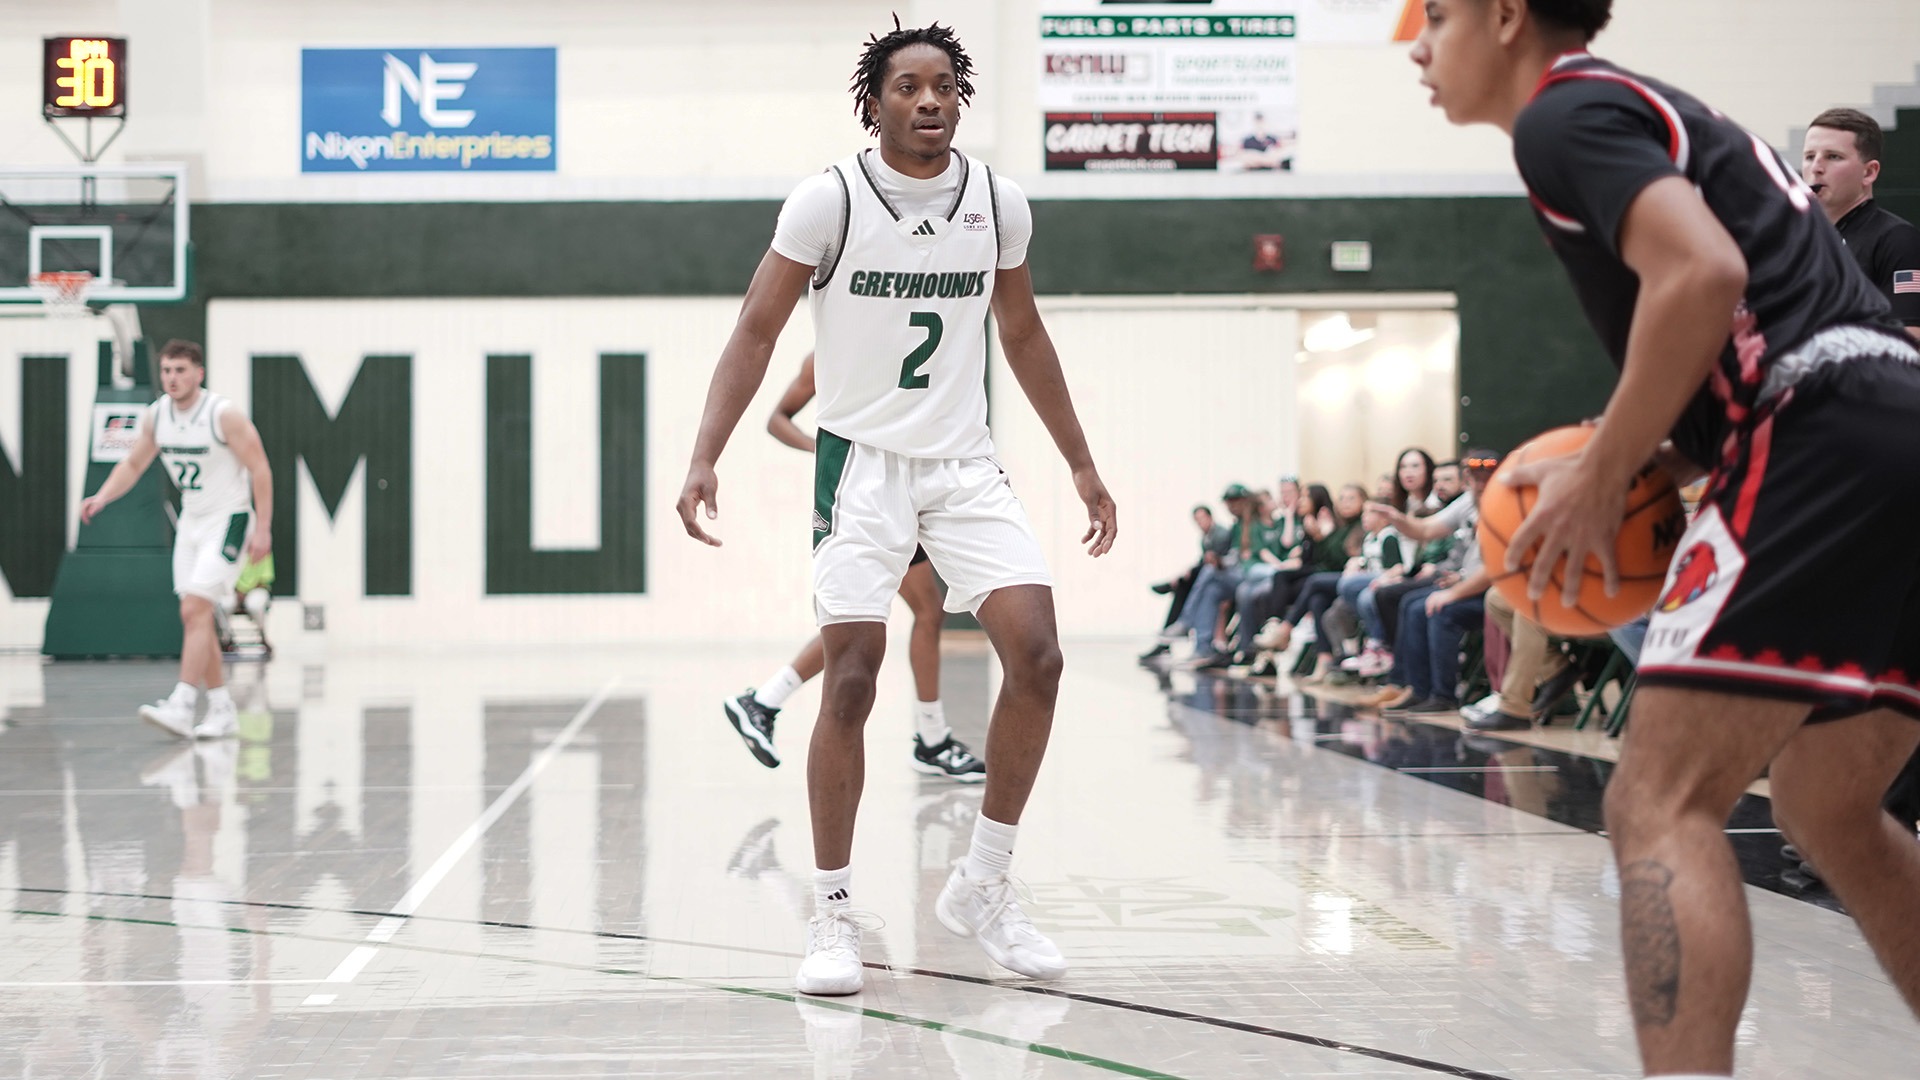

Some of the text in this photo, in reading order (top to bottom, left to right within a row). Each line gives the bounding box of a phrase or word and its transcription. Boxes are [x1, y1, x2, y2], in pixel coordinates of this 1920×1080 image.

[1043, 17, 1294, 36] FUELS PARTS TIRES
[56, 57, 115, 107] 30
[380, 52, 479, 128] NE
[1046, 123, 1215, 153] CARPET TECH
[849, 270, 991, 299] GREYHOUNDS
[898, 311, 944, 390] 2
[172, 461, 203, 490] 22
